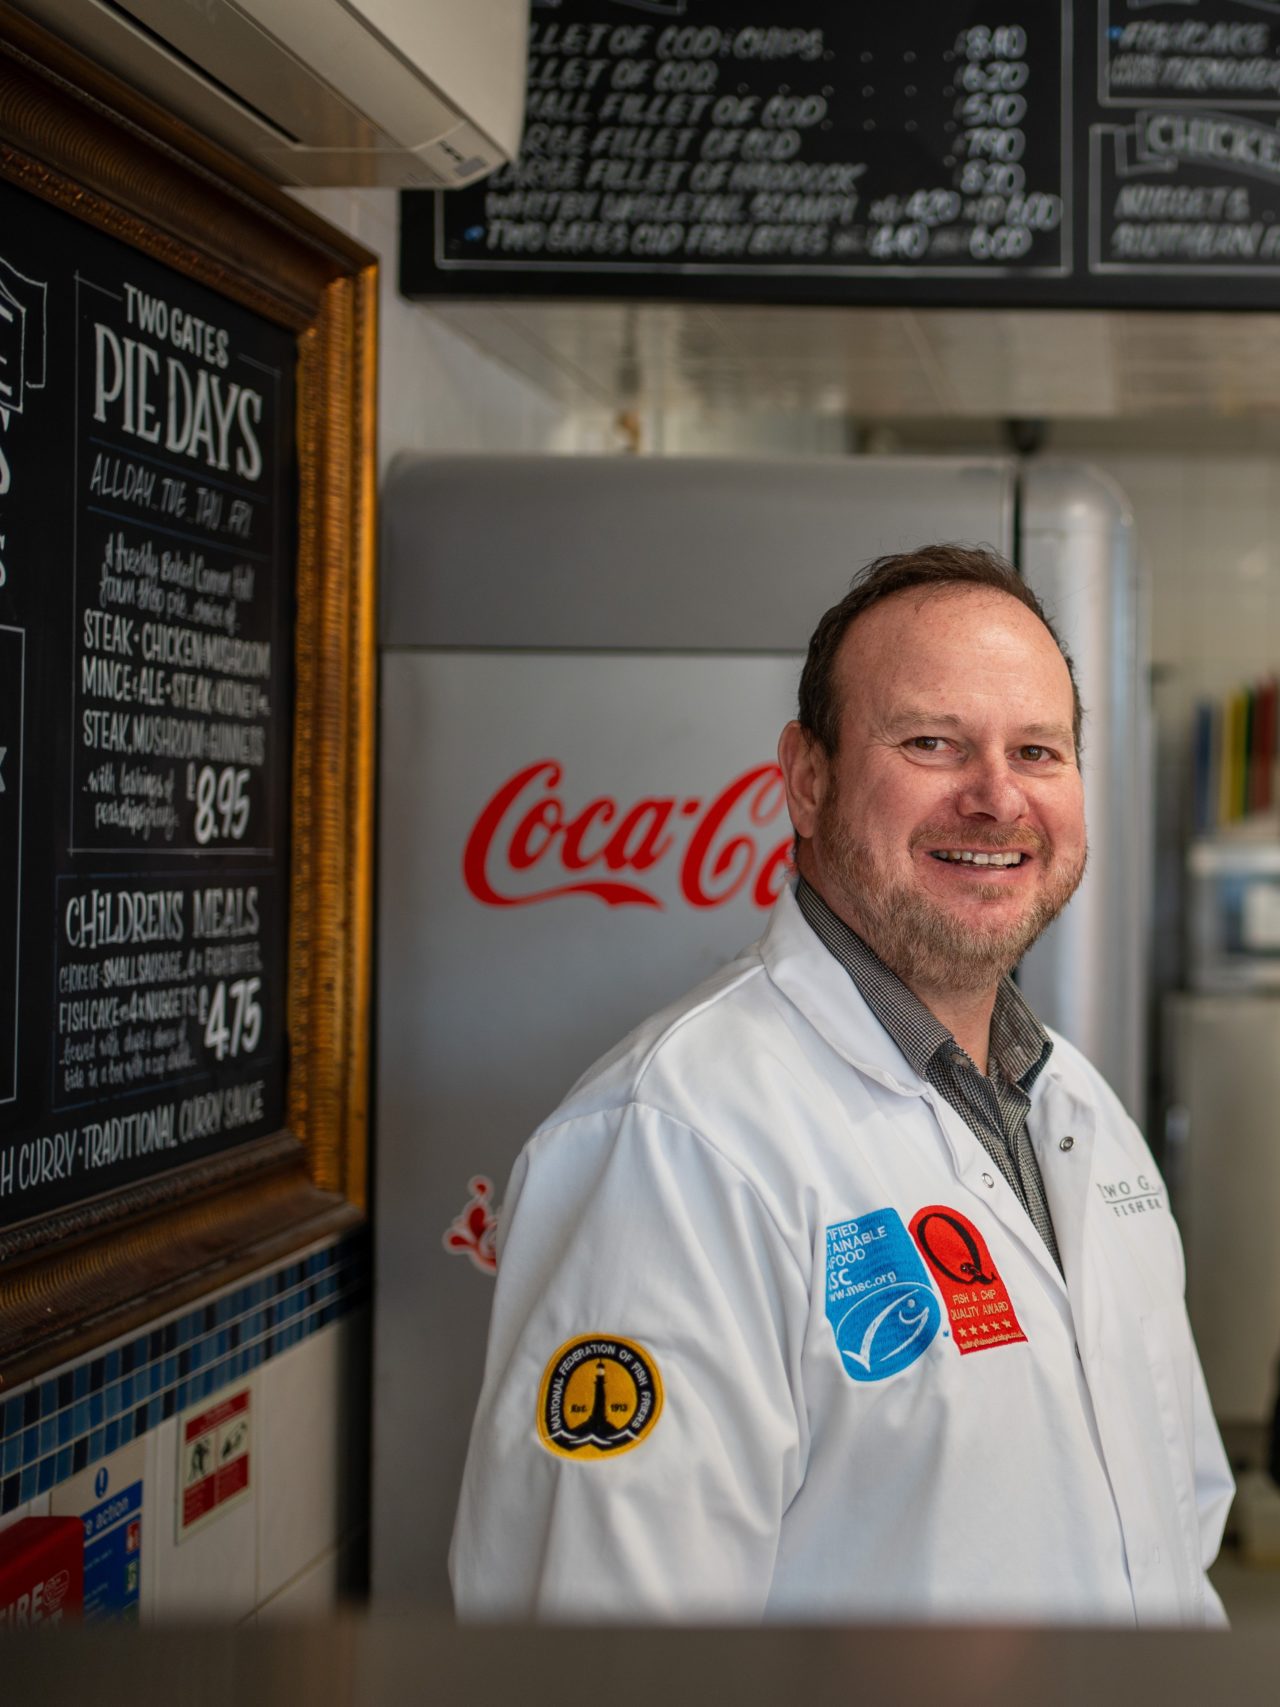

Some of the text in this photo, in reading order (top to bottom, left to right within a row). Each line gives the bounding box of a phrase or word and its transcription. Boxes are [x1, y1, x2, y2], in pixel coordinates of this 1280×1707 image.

[122, 281, 230, 369] TWO GATES
[93, 322, 263, 482] PIE DAYS
[83, 608, 134, 656] STEAK
[461, 757, 798, 913] Coca-Co
[192, 886, 260, 939] MEALS
[17, 1126, 79, 1191] CURRY
[82, 1101, 178, 1171] TRADITIONAL
[178, 1089, 226, 1145] CURRY
[950, 1301, 1009, 1321] QUALITY AWARD
[952, 1292, 970, 1306] FISH
[980, 1289, 997, 1301] CHIP
[551, 1376, 565, 1430] NATIONAL
[559, 1343, 617, 1377] FEDERATION
[618, 1349, 635, 1363] OF
[630, 1362, 649, 1387] FISH
[610, 1403, 629, 1413] 1913
